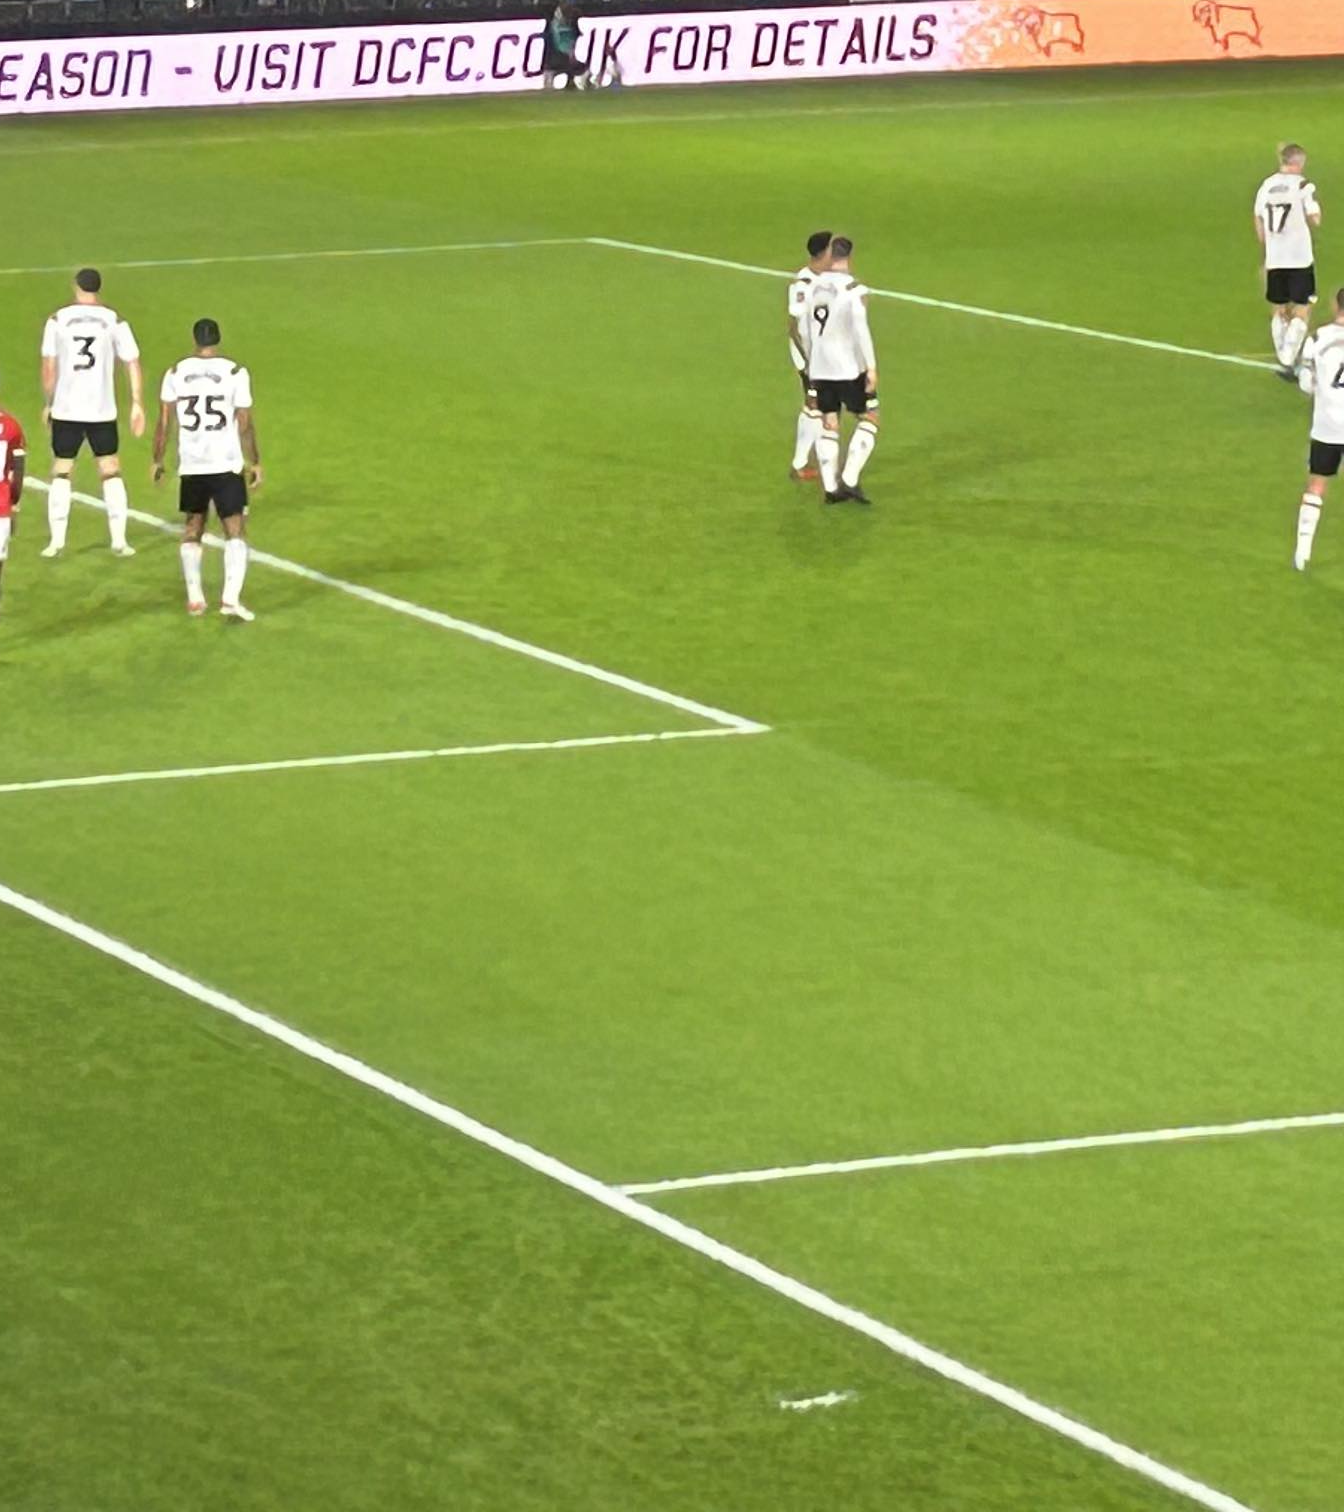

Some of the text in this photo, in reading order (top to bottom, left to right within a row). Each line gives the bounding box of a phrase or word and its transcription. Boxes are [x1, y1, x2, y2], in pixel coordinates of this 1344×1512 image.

[213, 41, 338, 92] VISIT
[644, 24, 733, 73] FOR
[751, 14, 940, 68] DETAILS
[1264, 202, 1292, 234] 17
[813, 303, 830, 337] 9
[73, 336, 96, 371] 3
[176, 394, 227, 432] 35
